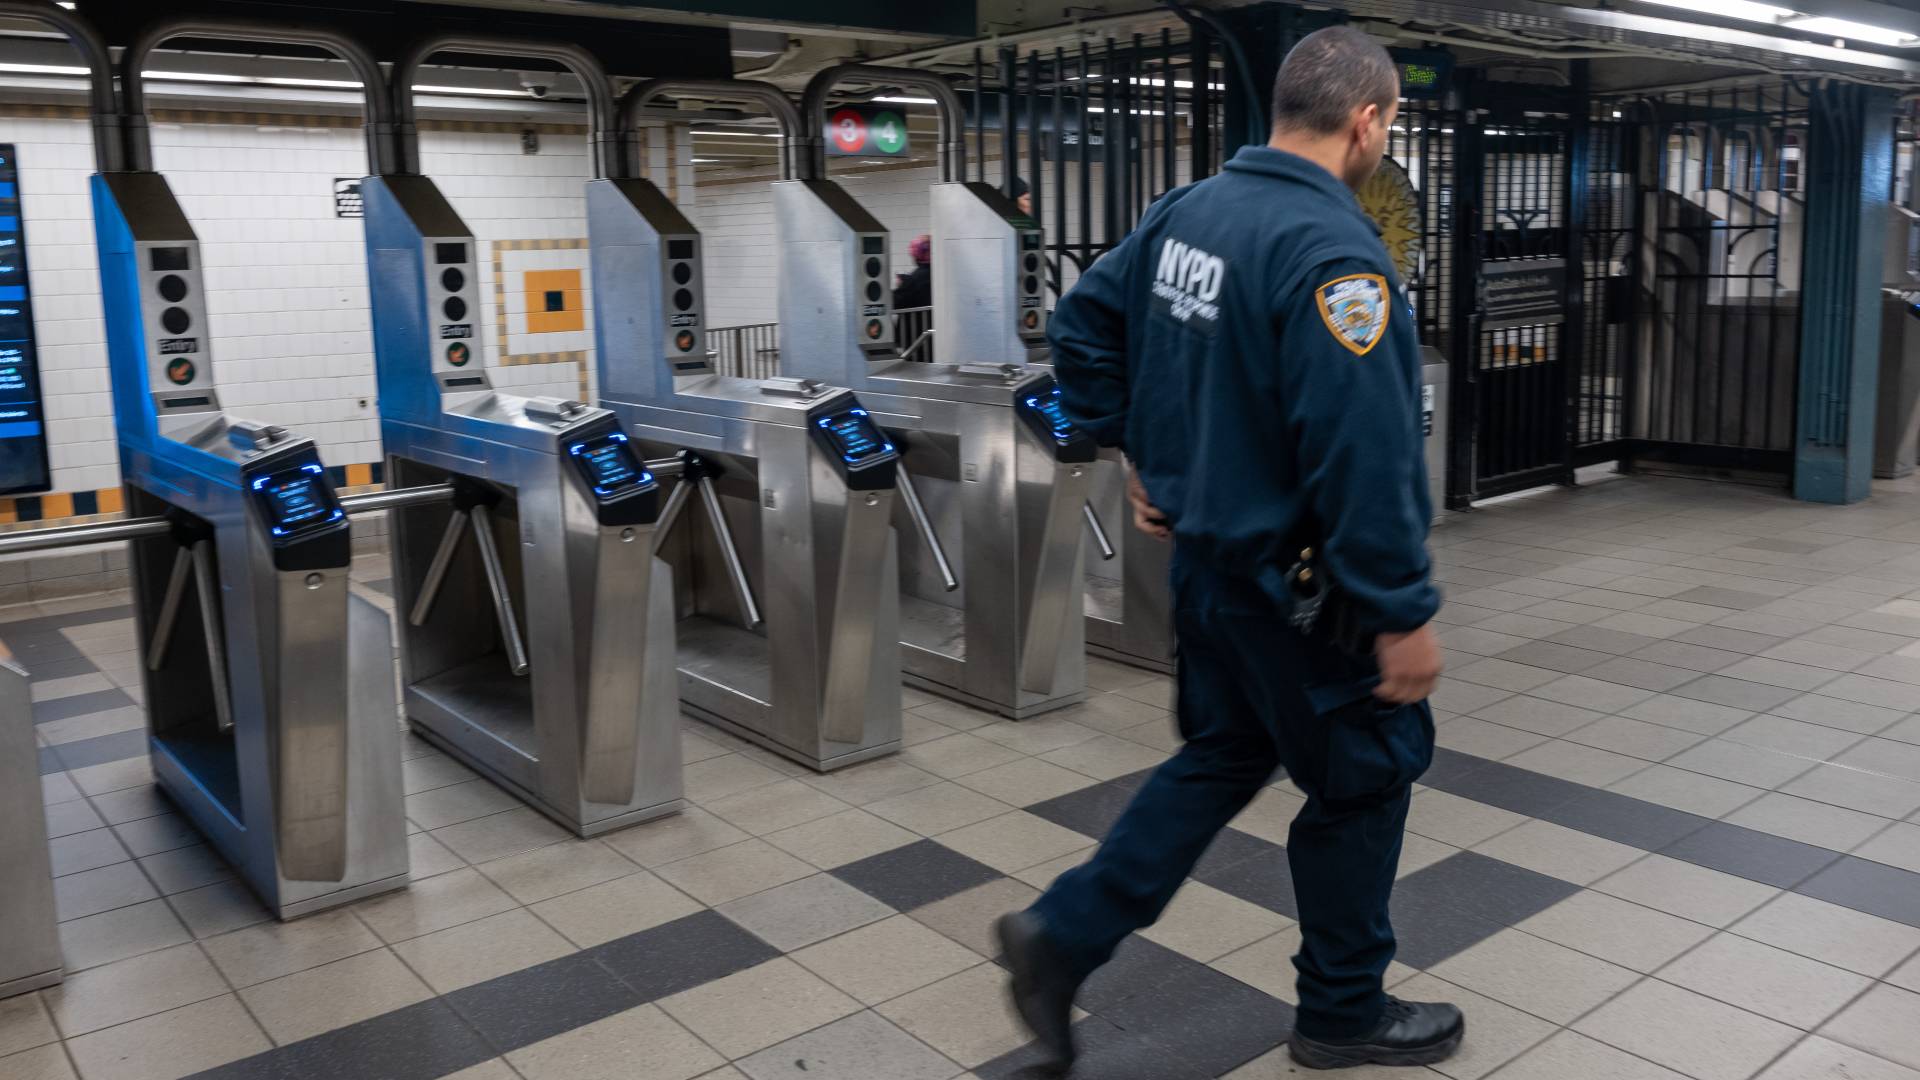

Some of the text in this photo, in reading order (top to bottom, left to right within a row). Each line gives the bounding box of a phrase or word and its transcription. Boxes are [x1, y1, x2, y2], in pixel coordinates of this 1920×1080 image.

[840, 118, 899, 144] 3 4
[1156, 238, 1224, 303] NYPD
[671, 315, 696, 327] Entry
[441, 325, 471, 338] Entry
[158, 340, 197, 353] Entry
